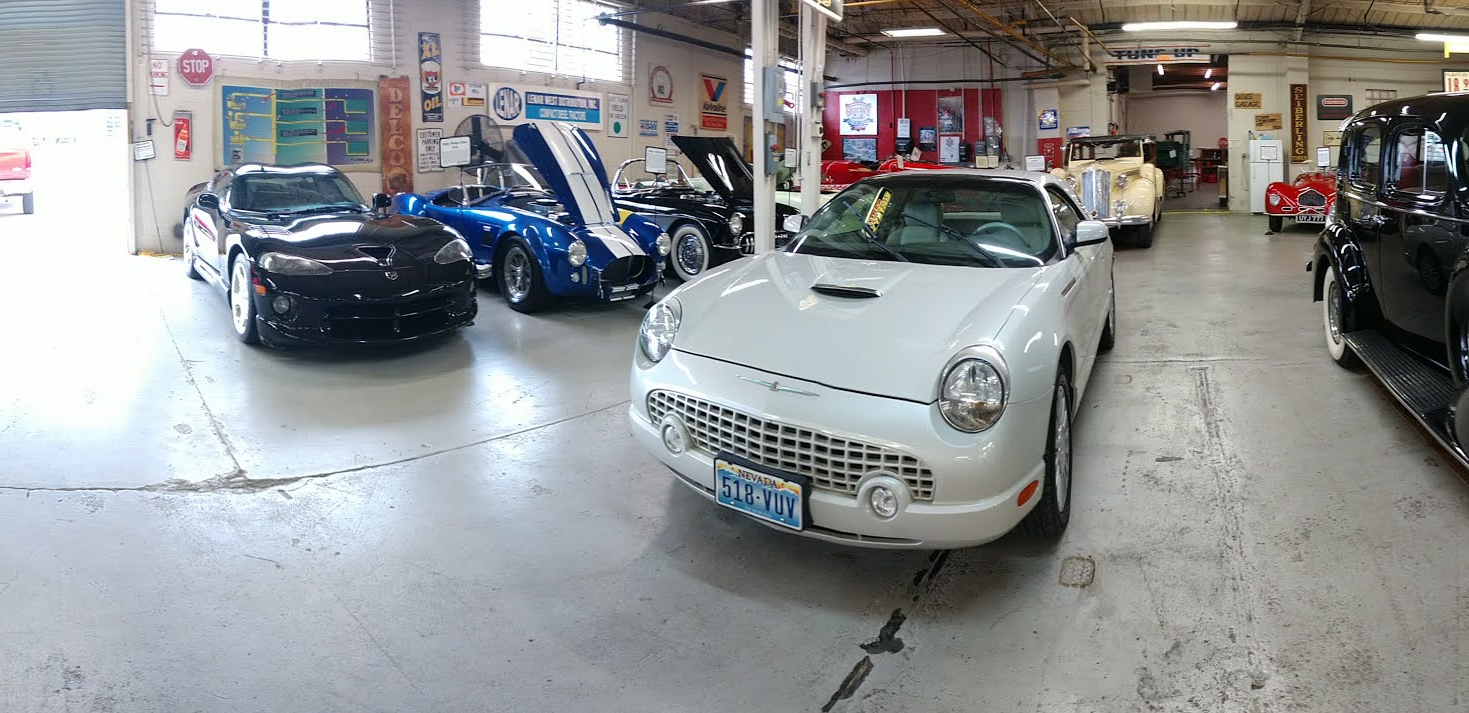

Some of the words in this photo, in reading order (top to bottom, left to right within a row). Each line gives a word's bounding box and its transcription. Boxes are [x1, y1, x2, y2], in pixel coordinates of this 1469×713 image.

[421, 42, 440, 60] XL
[182, 59, 210, 74] STOP
[424, 96, 442, 112] OIL
[388, 87, 405, 166] DELCO
[1294, 86, 1304, 155] SEIBERLING
[738, 468, 778, 489] NEVADA
